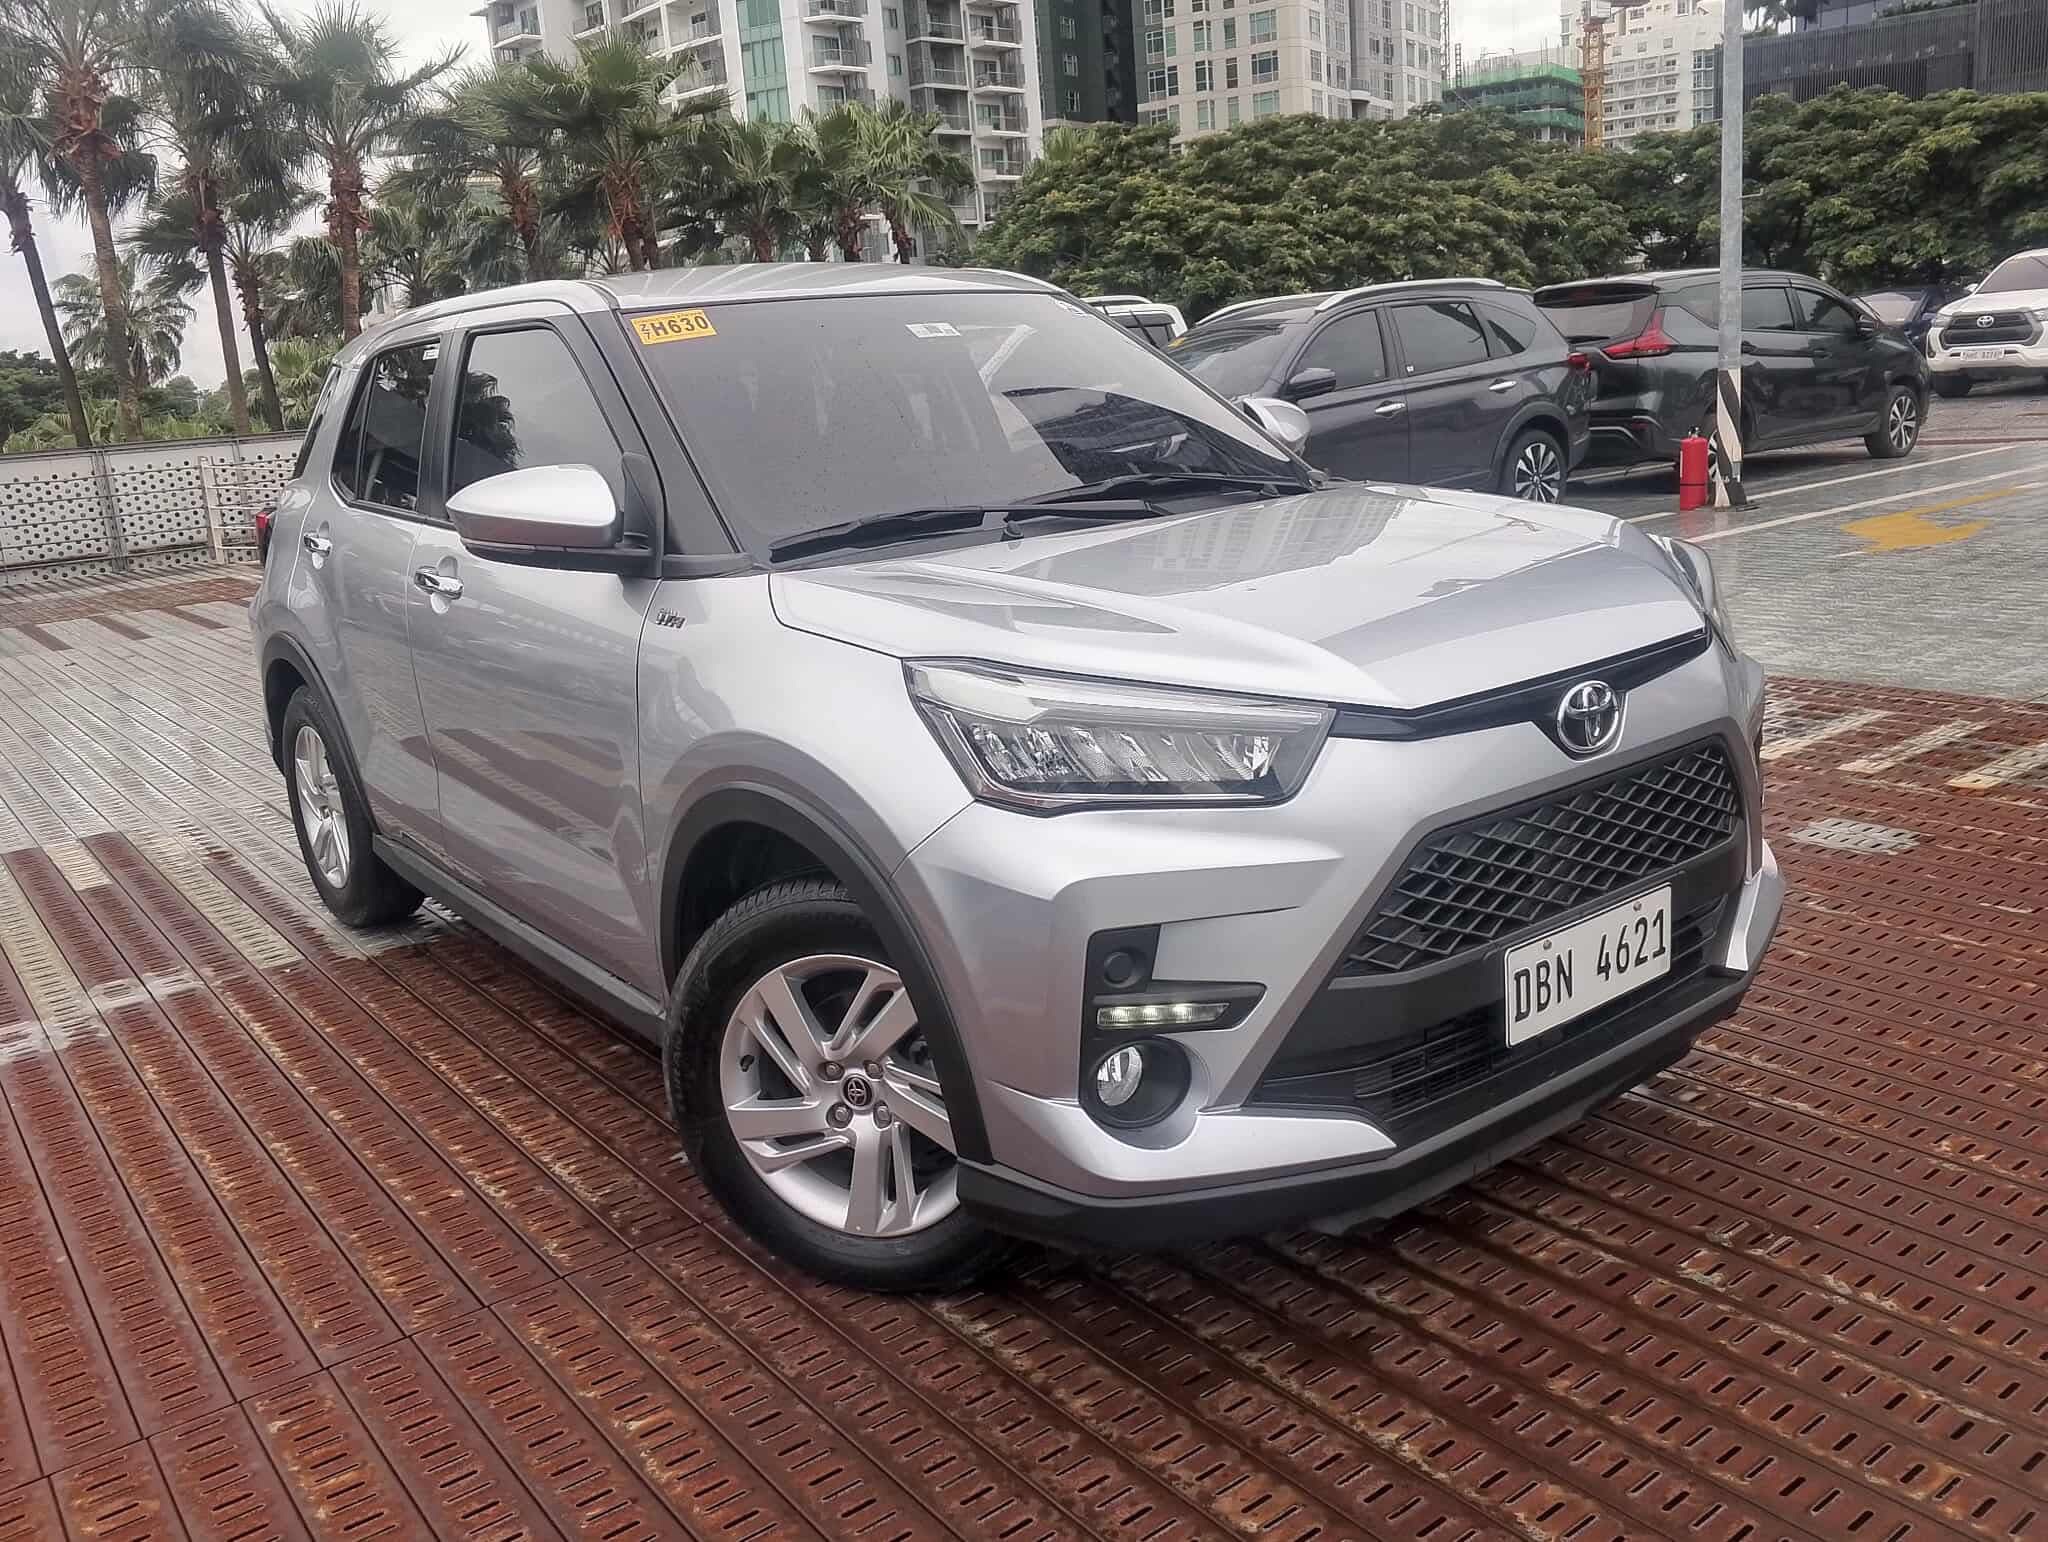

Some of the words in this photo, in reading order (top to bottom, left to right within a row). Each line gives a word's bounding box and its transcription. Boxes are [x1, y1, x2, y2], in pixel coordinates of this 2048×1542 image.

[650, 315, 709, 336] H630
[1514, 949, 1573, 1023] DBN
[1596, 908, 1667, 981] 4621
